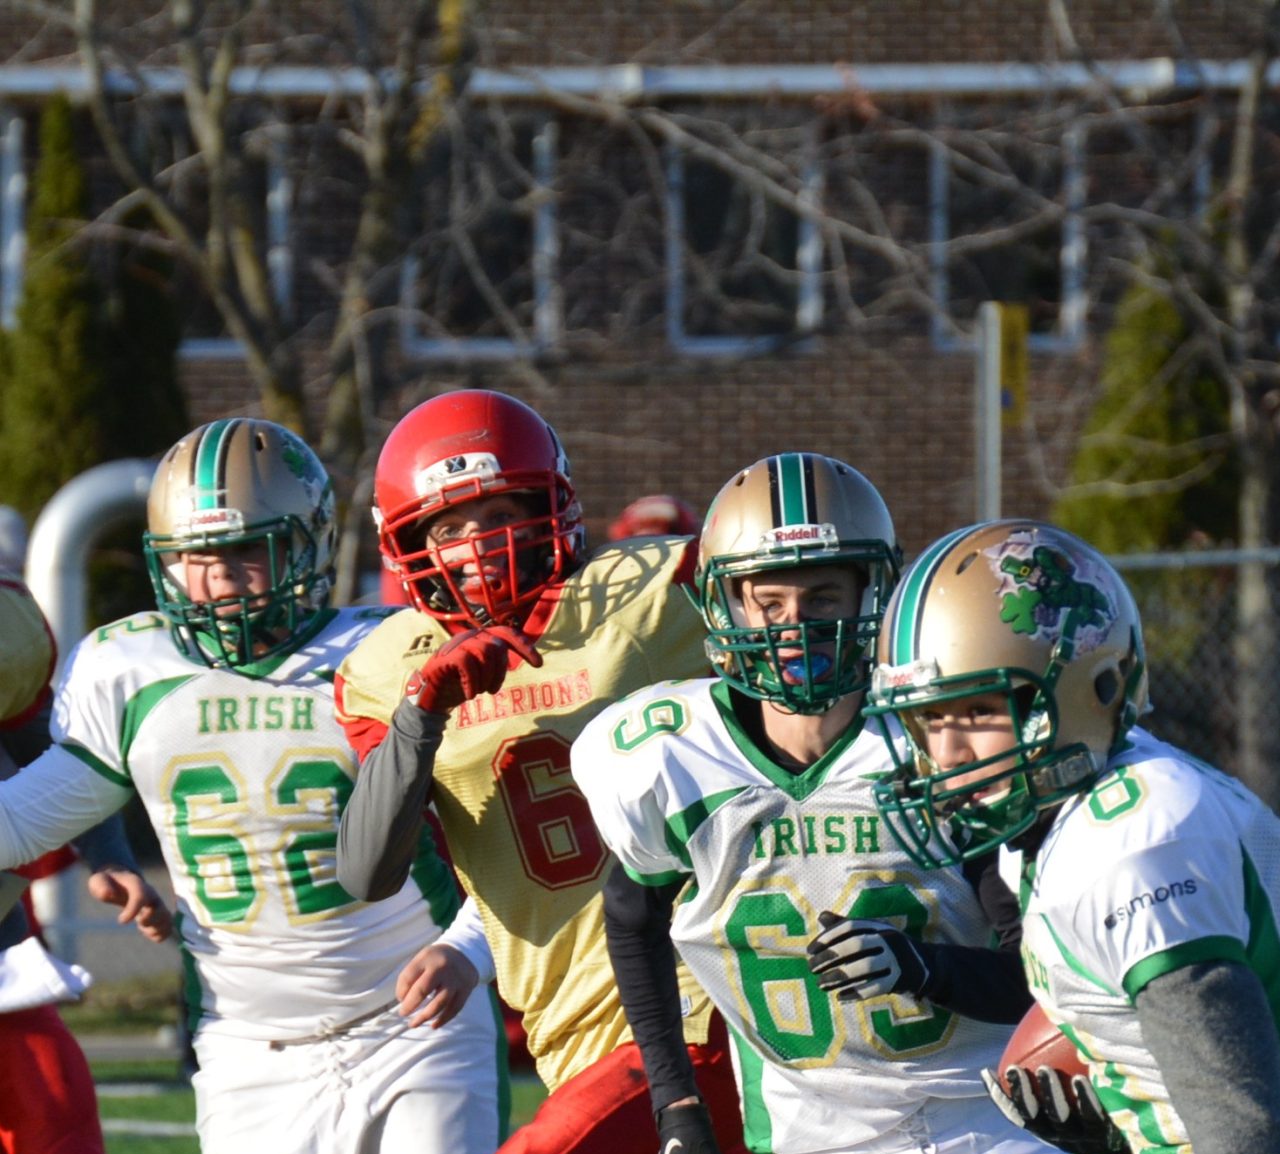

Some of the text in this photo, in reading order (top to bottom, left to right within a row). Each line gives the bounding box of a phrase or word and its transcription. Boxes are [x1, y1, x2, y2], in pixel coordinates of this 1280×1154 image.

[775, 526, 820, 541] Riddell
[198, 697, 315, 735] IRISH
[456, 669, 593, 730] ALERIONS
[492, 730, 609, 891] 6
[162, 750, 357, 932] 62
[752, 814, 882, 858] IRISH
[1117, 878, 1198, 921] simons
